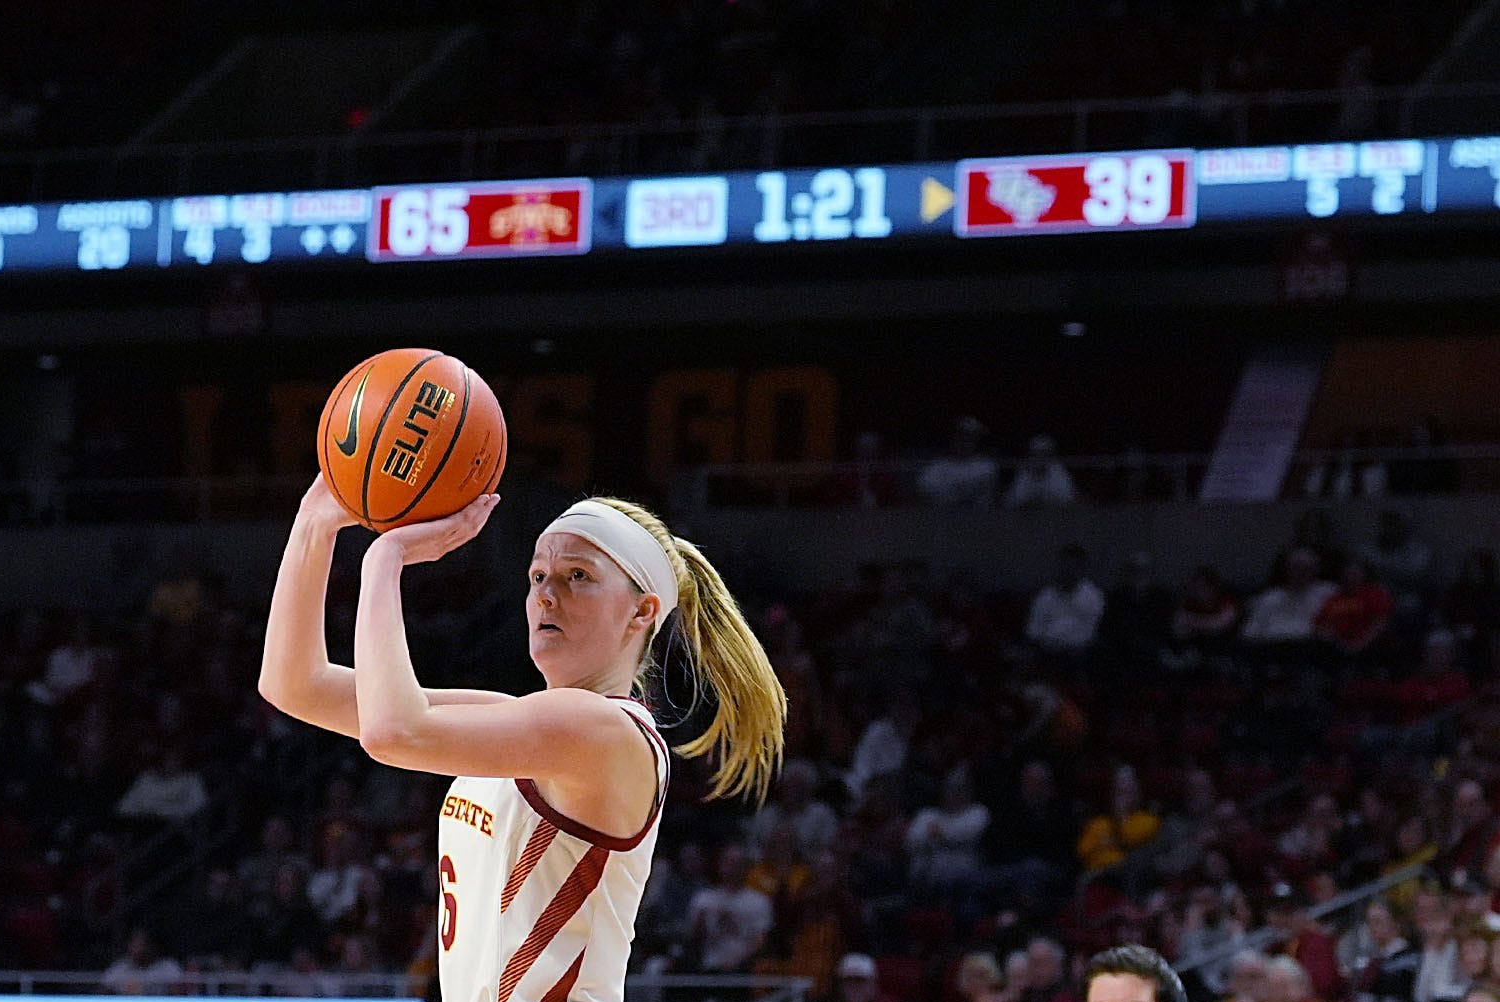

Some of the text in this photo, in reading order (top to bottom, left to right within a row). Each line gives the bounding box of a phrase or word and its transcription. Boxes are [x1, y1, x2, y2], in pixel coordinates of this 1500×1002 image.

[387, 188, 470, 256] 65
[754, 168, 892, 241] 1:21
[1084, 156, 1172, 227] 39
[381, 379, 449, 483] ELITE
[444, 796, 496, 838] STATE
